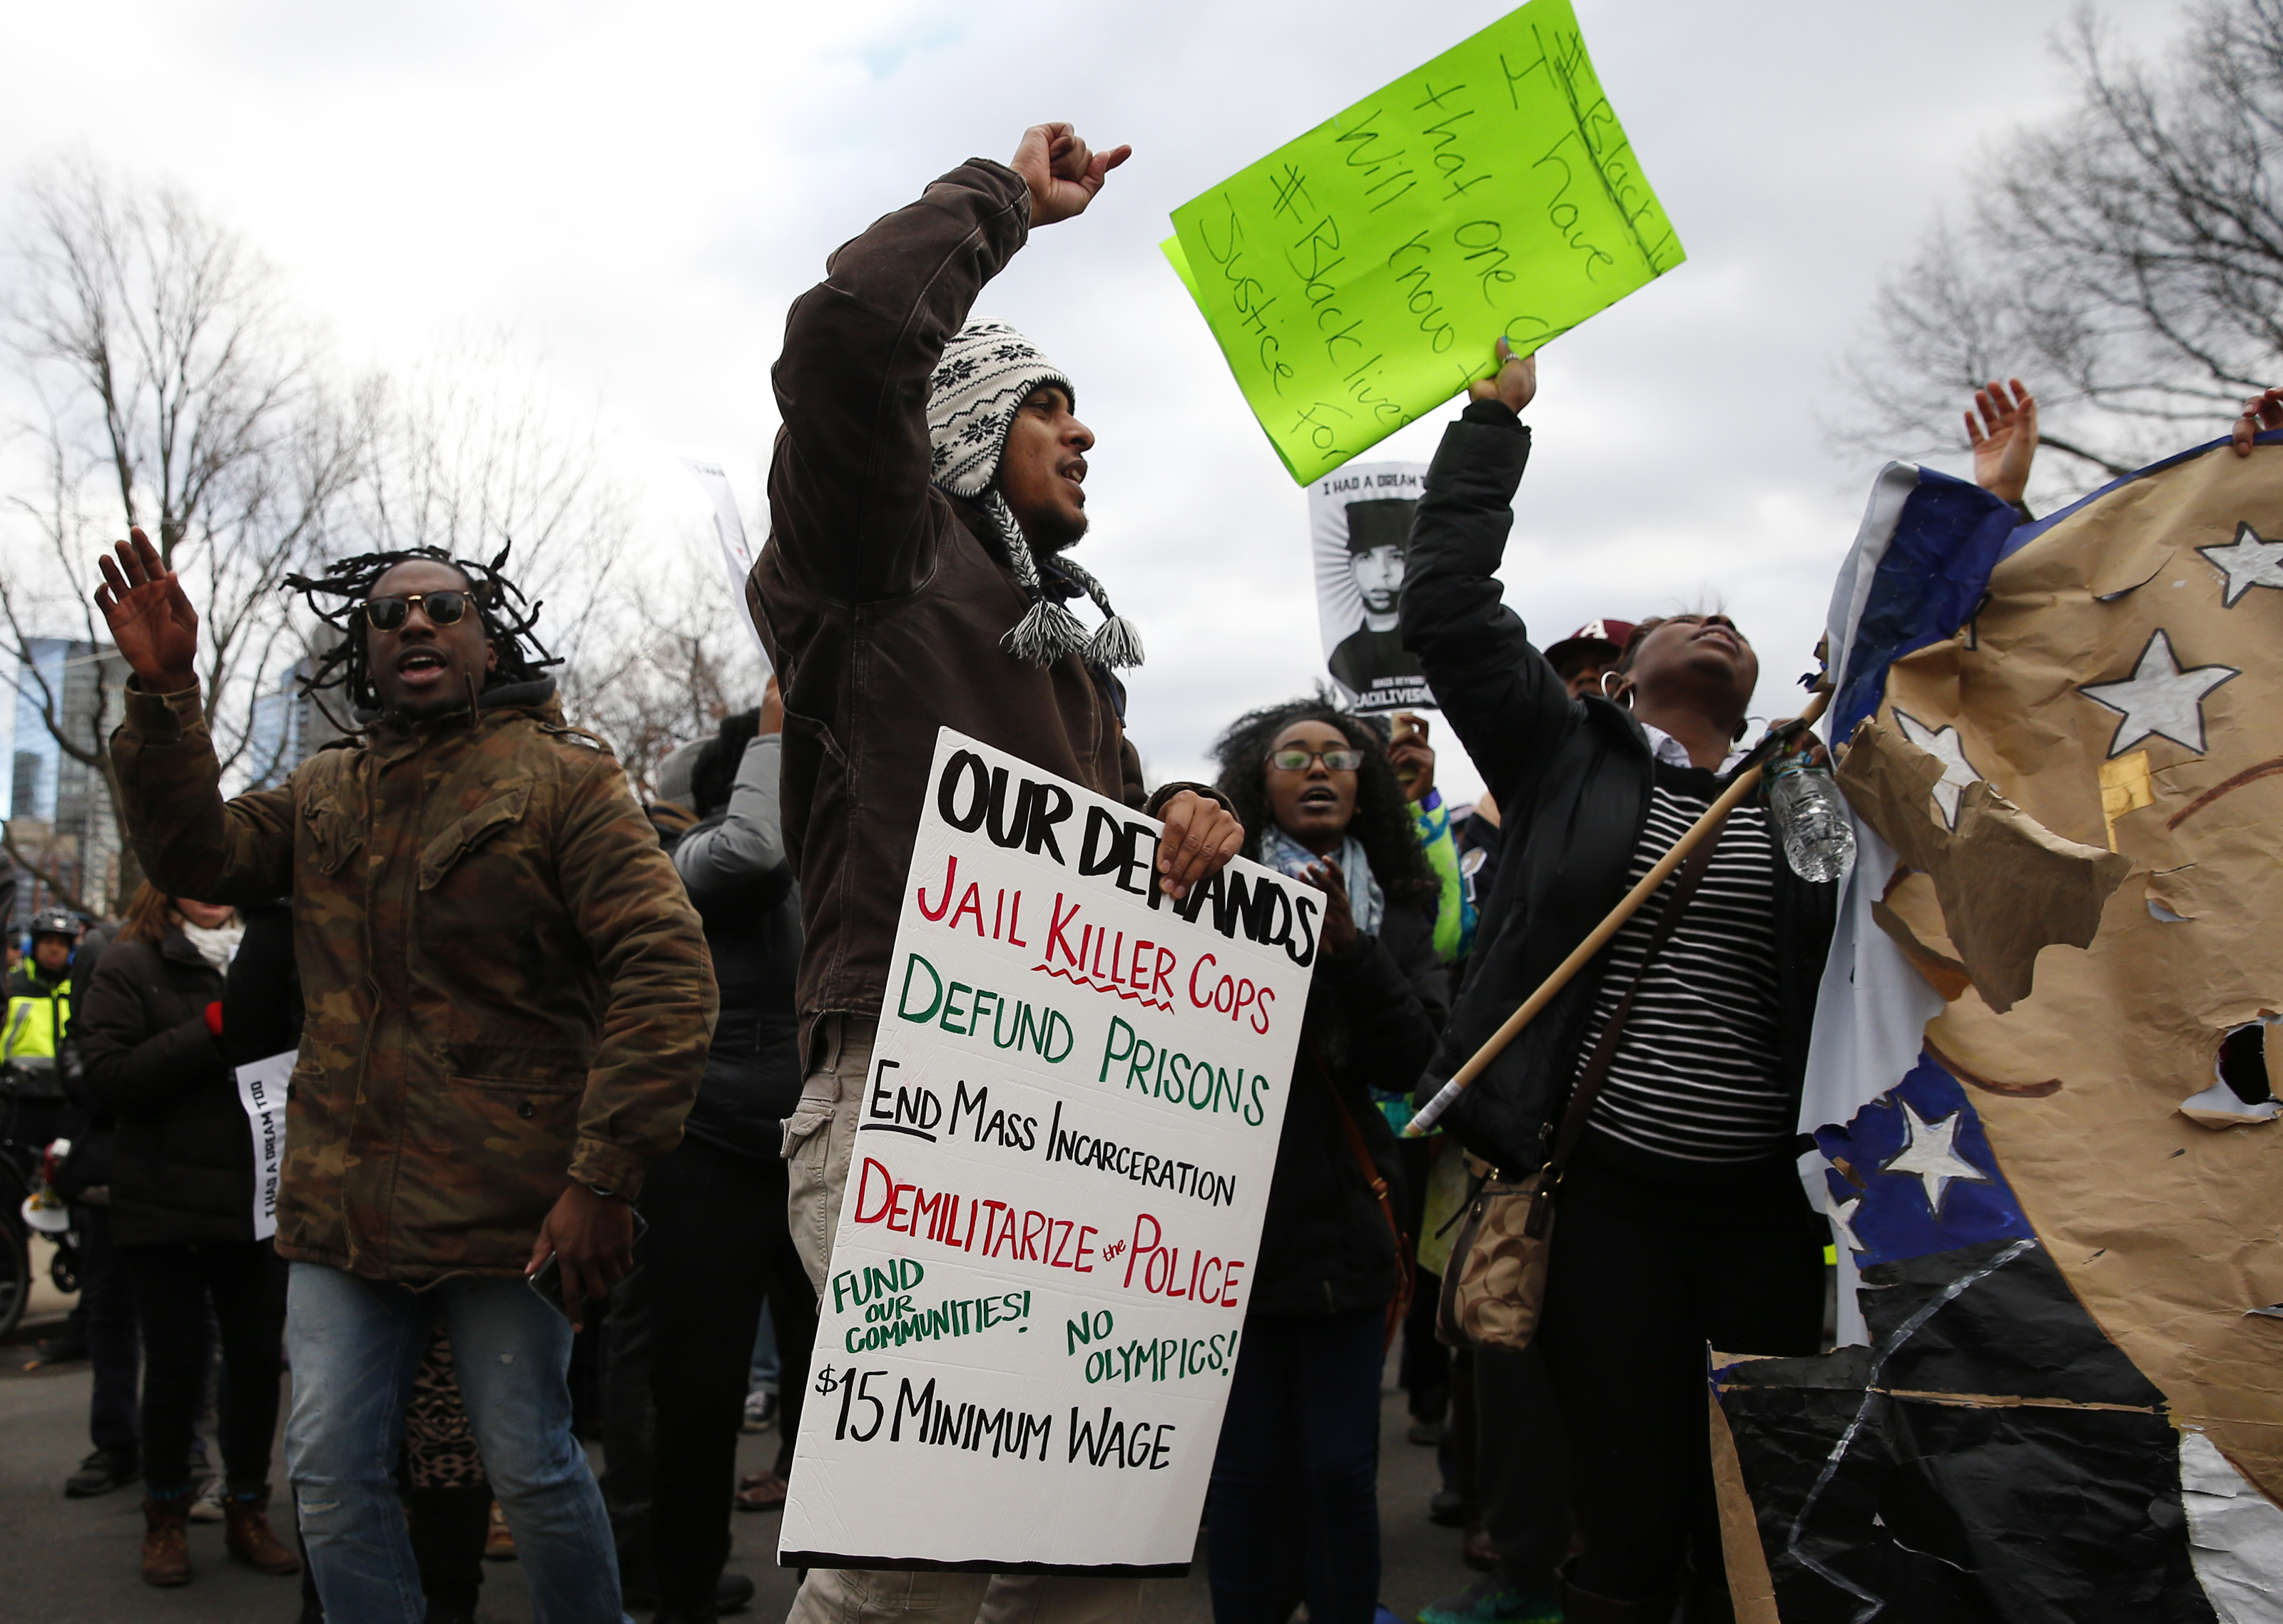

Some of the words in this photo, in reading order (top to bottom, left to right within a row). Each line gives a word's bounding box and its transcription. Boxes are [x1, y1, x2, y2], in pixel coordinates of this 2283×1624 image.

[1413, 83, 1492, 201] that
[1532, 130, 1614, 284] have
[1200, 192, 1293, 397] Justice
[1323, 482, 1330, 495] I
[1333, 476, 1359, 492] HAD
[1364, 476, 1373, 488] A
[1378, 473, 1416, 487] DREAM
[1579, 619, 1608, 640] A
[937, 750, 1073, 866] OUR
[917, 856, 1027, 948] JAIL
[1044, 892, 1177, 998] KILLER
[1189, 953, 1276, 1034] COPS
[898, 954, 1074, 1064] DEFUND
[1099, 1016, 1268, 1126] PRISONS
[251, 1081, 267, 1108] TOO
[261, 1111, 275, 1161] DREAM
[870, 1059, 942, 1130] END
[947, 1081, 1037, 1151] MASS
[1046, 1101, 1236, 1207] INCARCERATION
[265, 1176, 277, 1206] HAD
[267, 1162, 277, 1173] A
[855, 1157, 1099, 1272] DEMILITARIZE
[1102, 1238, 1126, 1262] the
[1124, 1214, 1244, 1307] POLICE
[832, 1258, 924, 1314] FUND
[865, 1295, 916, 1323] OUR
[846, 1290, 1030, 1354] COMMUNITIES!
[1067, 1309, 1113, 1356] NO
[1085, 1330, 1237, 1384] OLYMPICS!
[815, 1364, 888, 1441] $15
[891, 1378, 1052, 1461] MINIMUM
[1069, 1406, 1176, 1470] WAGE
